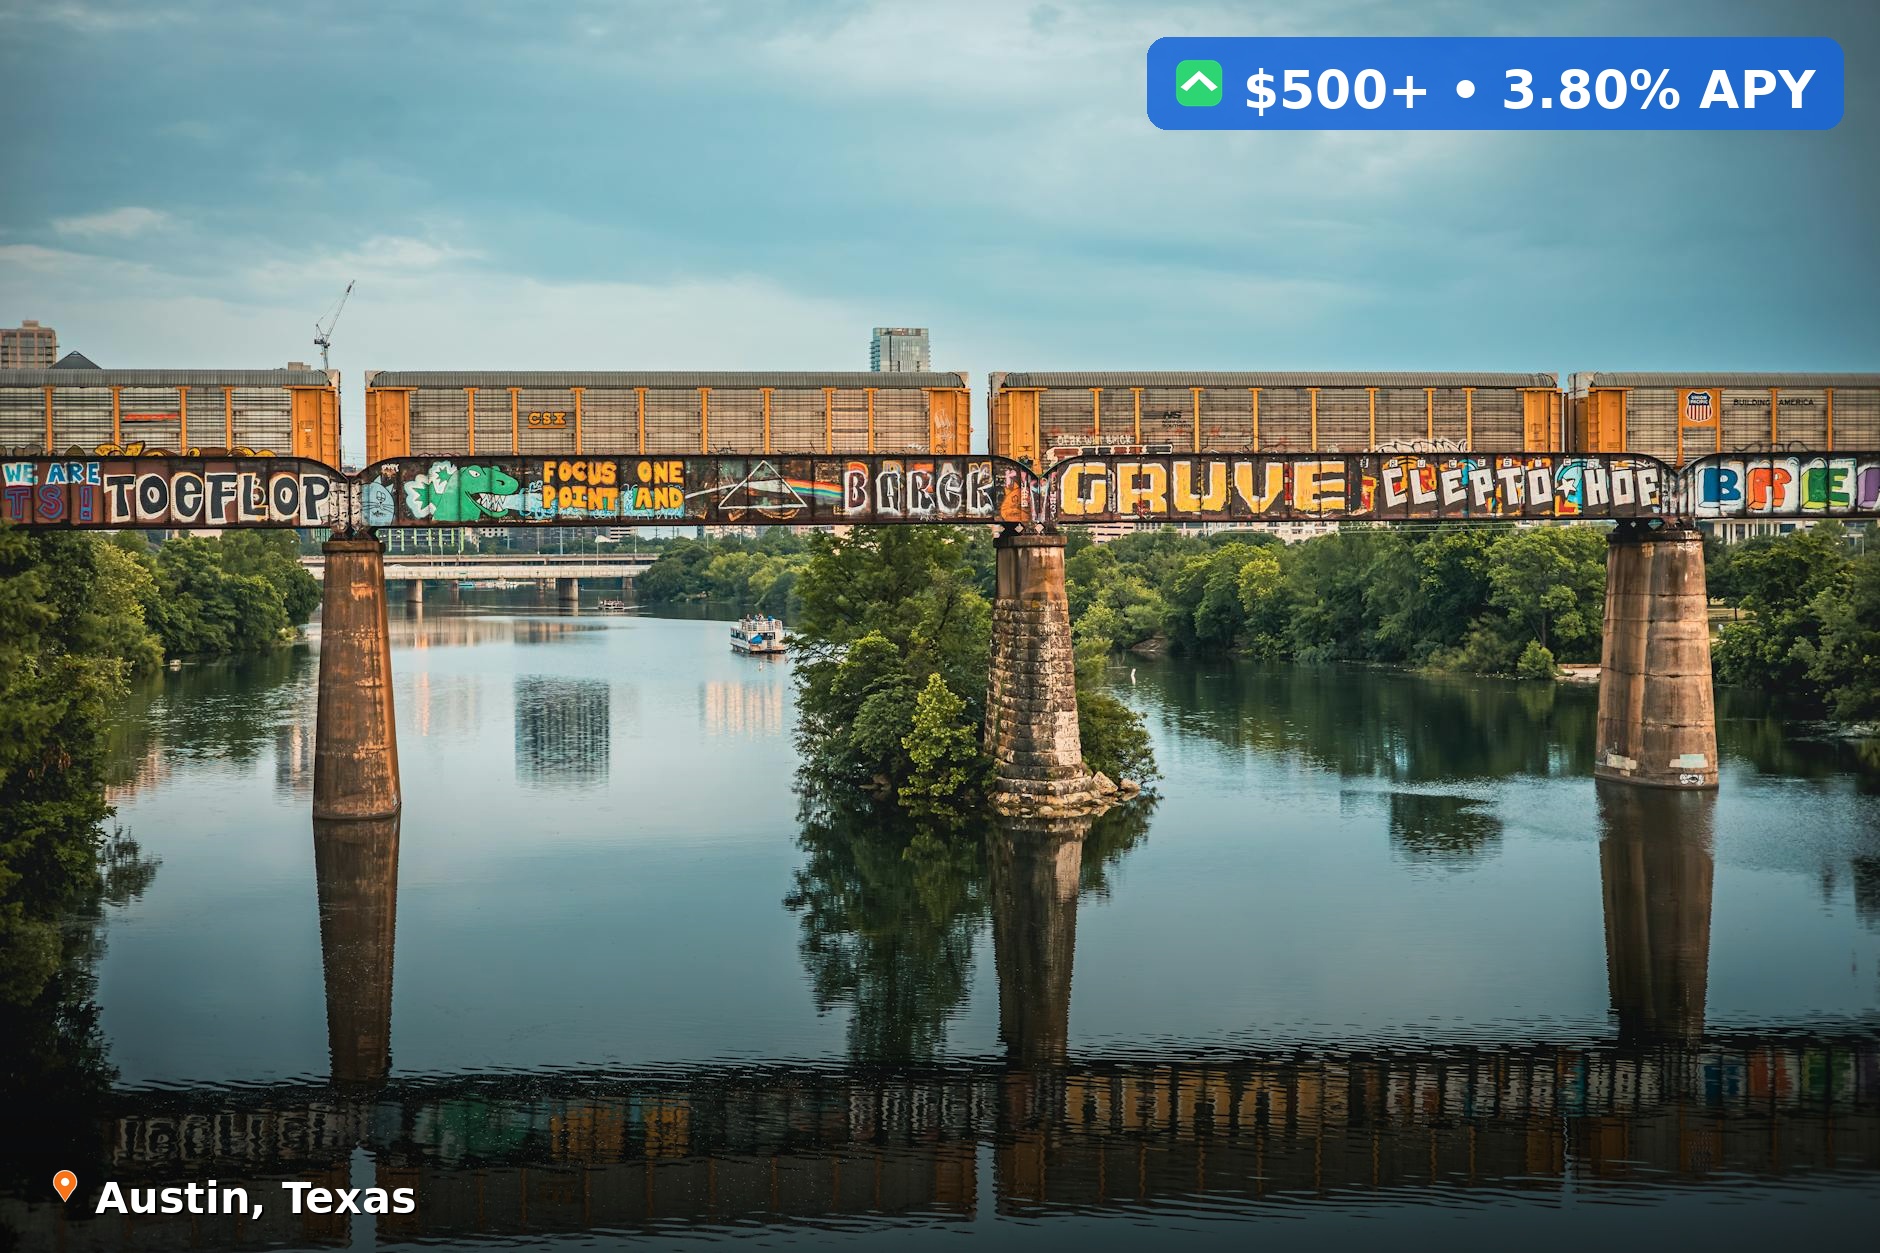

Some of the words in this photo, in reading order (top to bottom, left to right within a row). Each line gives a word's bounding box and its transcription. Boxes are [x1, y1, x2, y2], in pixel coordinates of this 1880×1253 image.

[528, 412, 567, 426] CSX
[2, 462, 38, 486] WE
[46, 462, 100, 486] ARE
[543, 460, 618, 485] FOCUS
[637, 460, 684, 484] ONE
[543, 485, 619, 511] POINT
[635, 487, 685, 510] AND
[1382, 468, 1553, 508] CLEPTO
